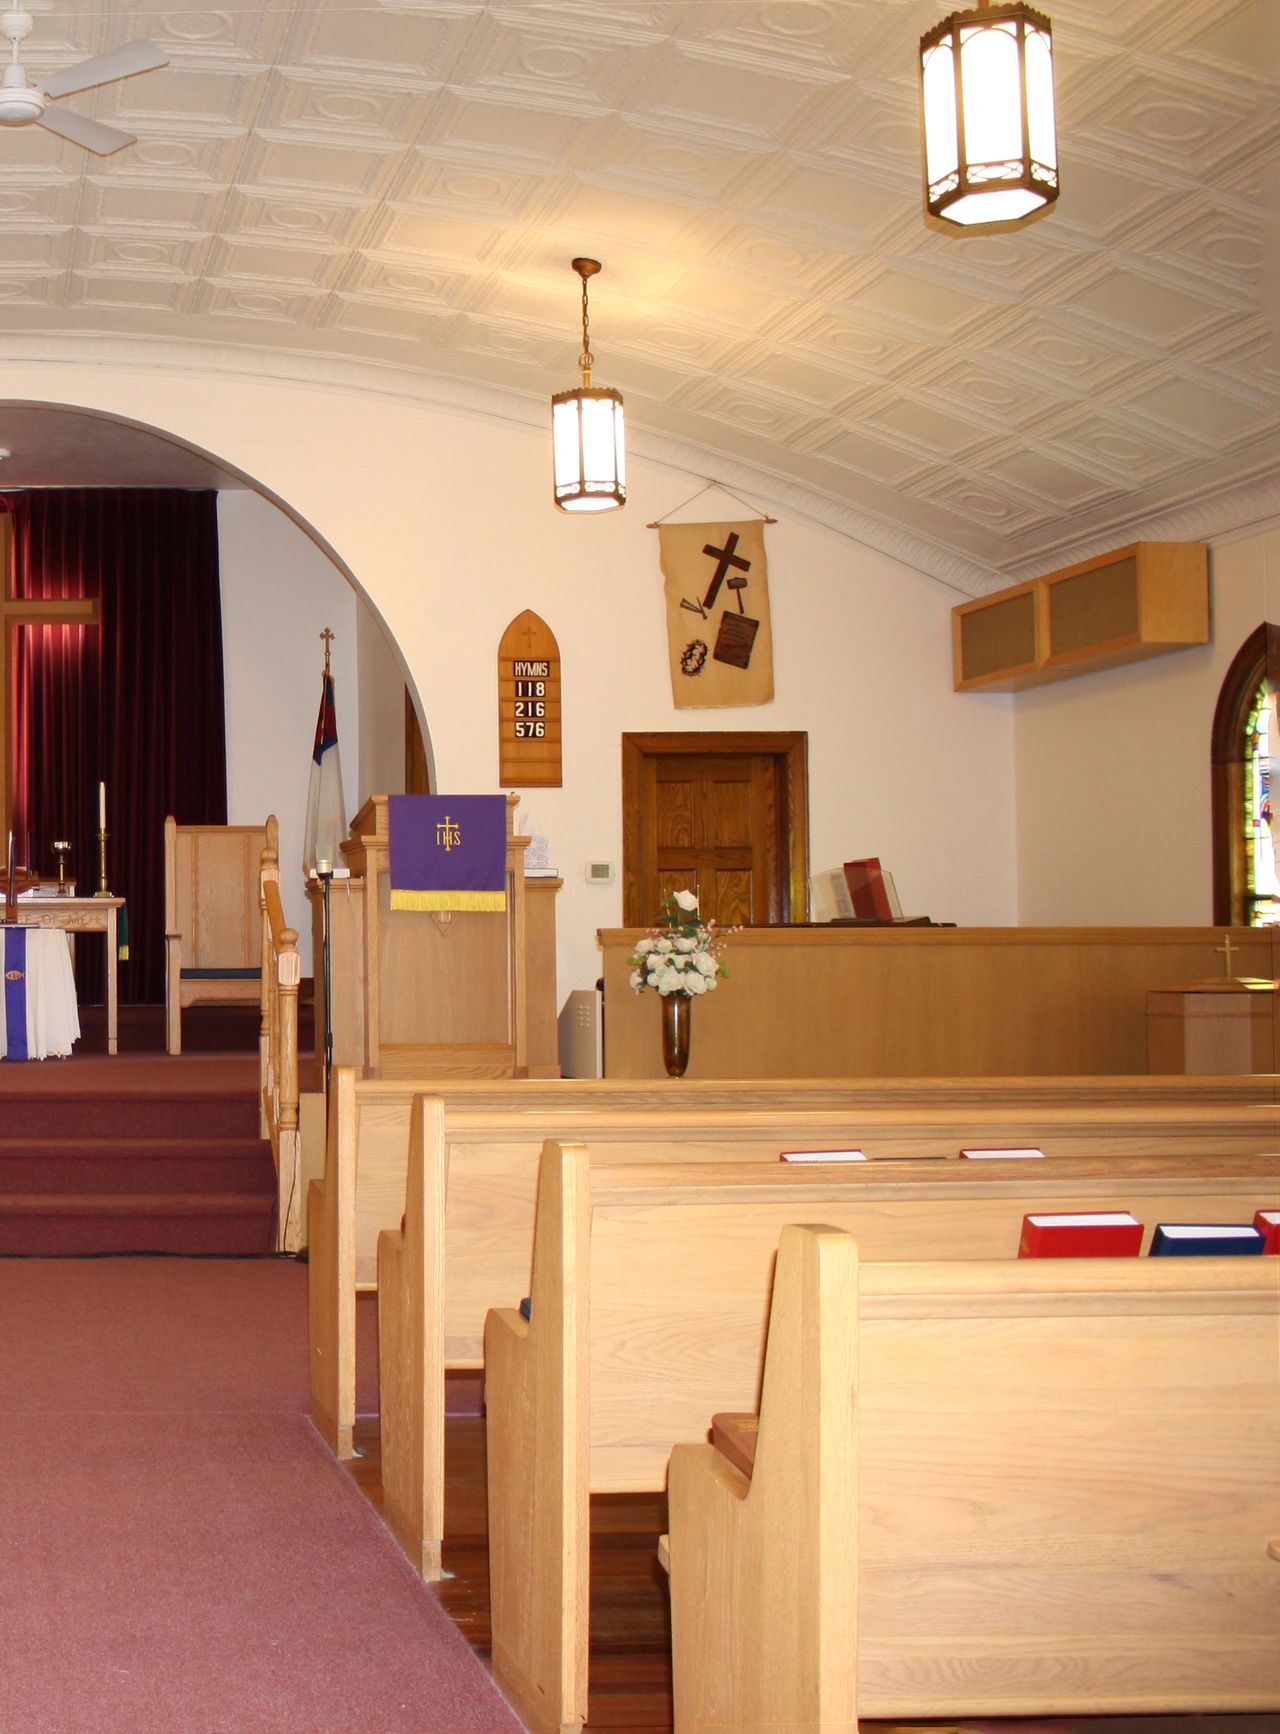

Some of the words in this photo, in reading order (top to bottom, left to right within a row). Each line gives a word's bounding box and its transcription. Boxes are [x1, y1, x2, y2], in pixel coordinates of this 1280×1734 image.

[514, 662, 548, 676] HYMNS
[517, 682, 545, 696] 118
[515, 702, 545, 717] 216
[515, 722, 545, 737] 576
[436, 831, 461, 846] IHS
